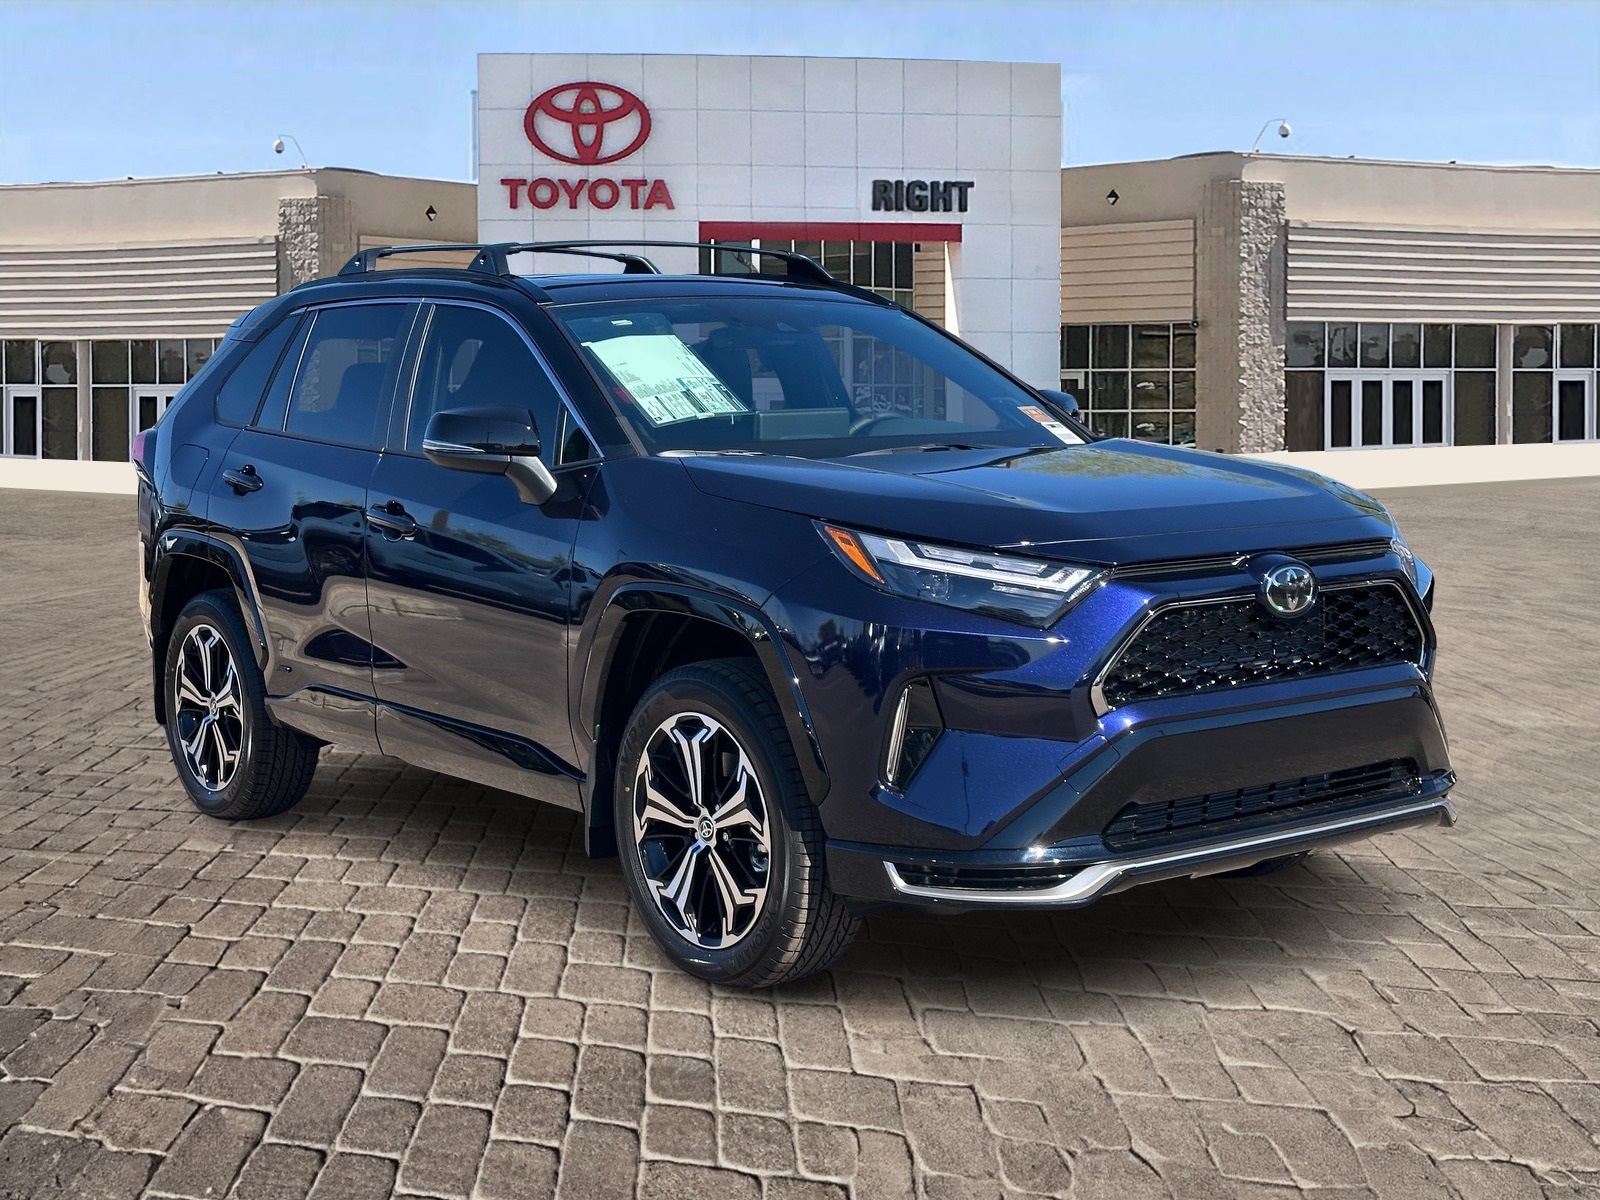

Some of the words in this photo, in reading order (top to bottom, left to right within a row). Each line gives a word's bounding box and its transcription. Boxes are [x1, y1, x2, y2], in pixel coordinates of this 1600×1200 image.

[501, 178, 674, 210] TOYOTA
[872, 179, 975, 212] RIGHT
[727, 910, 776, 971] YOKOHAMA
